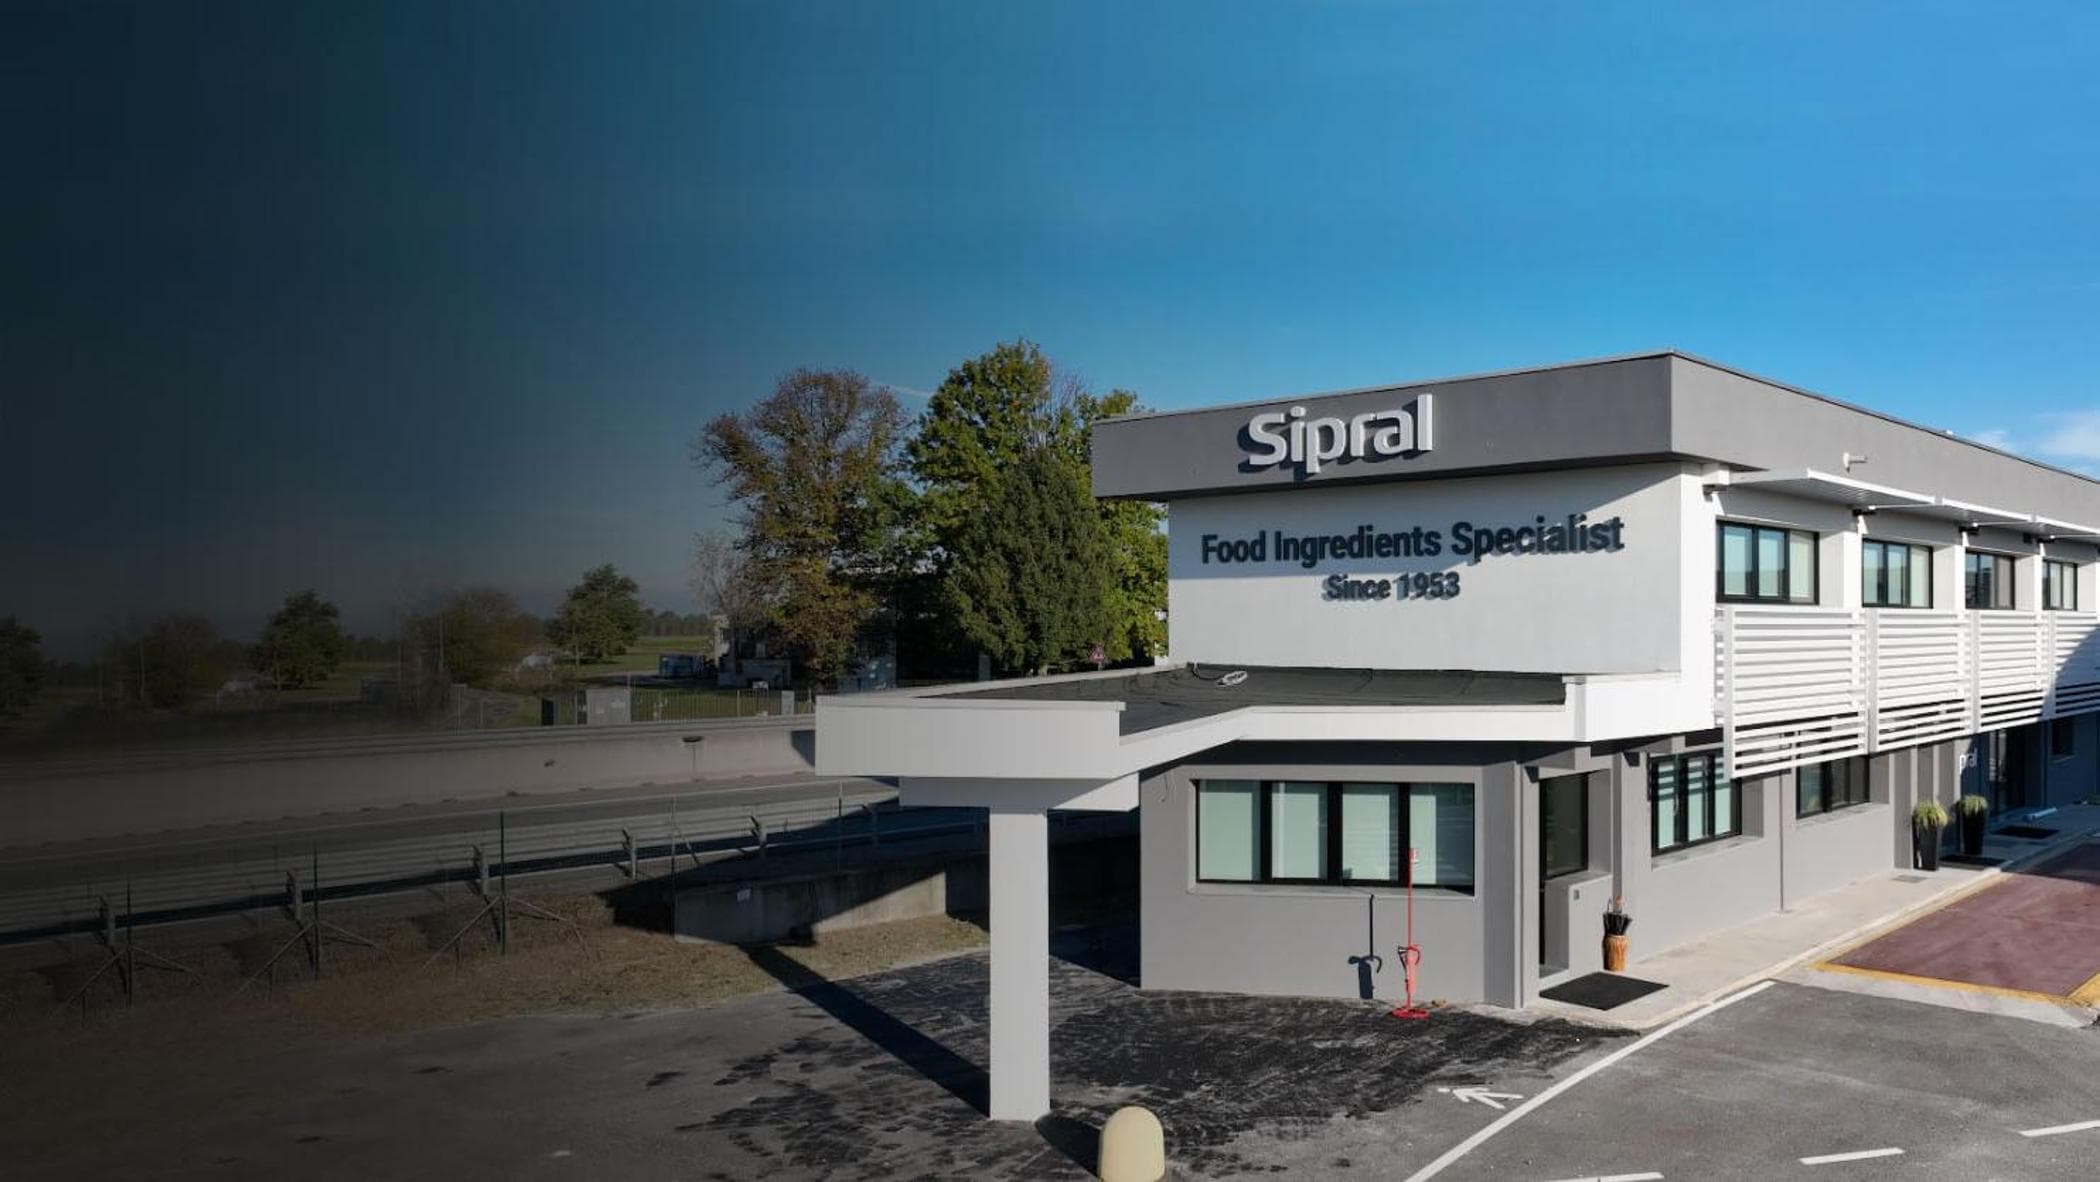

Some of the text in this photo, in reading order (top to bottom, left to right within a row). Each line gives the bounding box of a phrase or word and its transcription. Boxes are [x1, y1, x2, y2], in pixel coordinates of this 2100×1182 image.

[1248, 393, 1433, 474] Sipral
[1201, 513, 1625, 569] Food Ingredients Specialist
[1325, 571, 1460, 600] Since 1953
